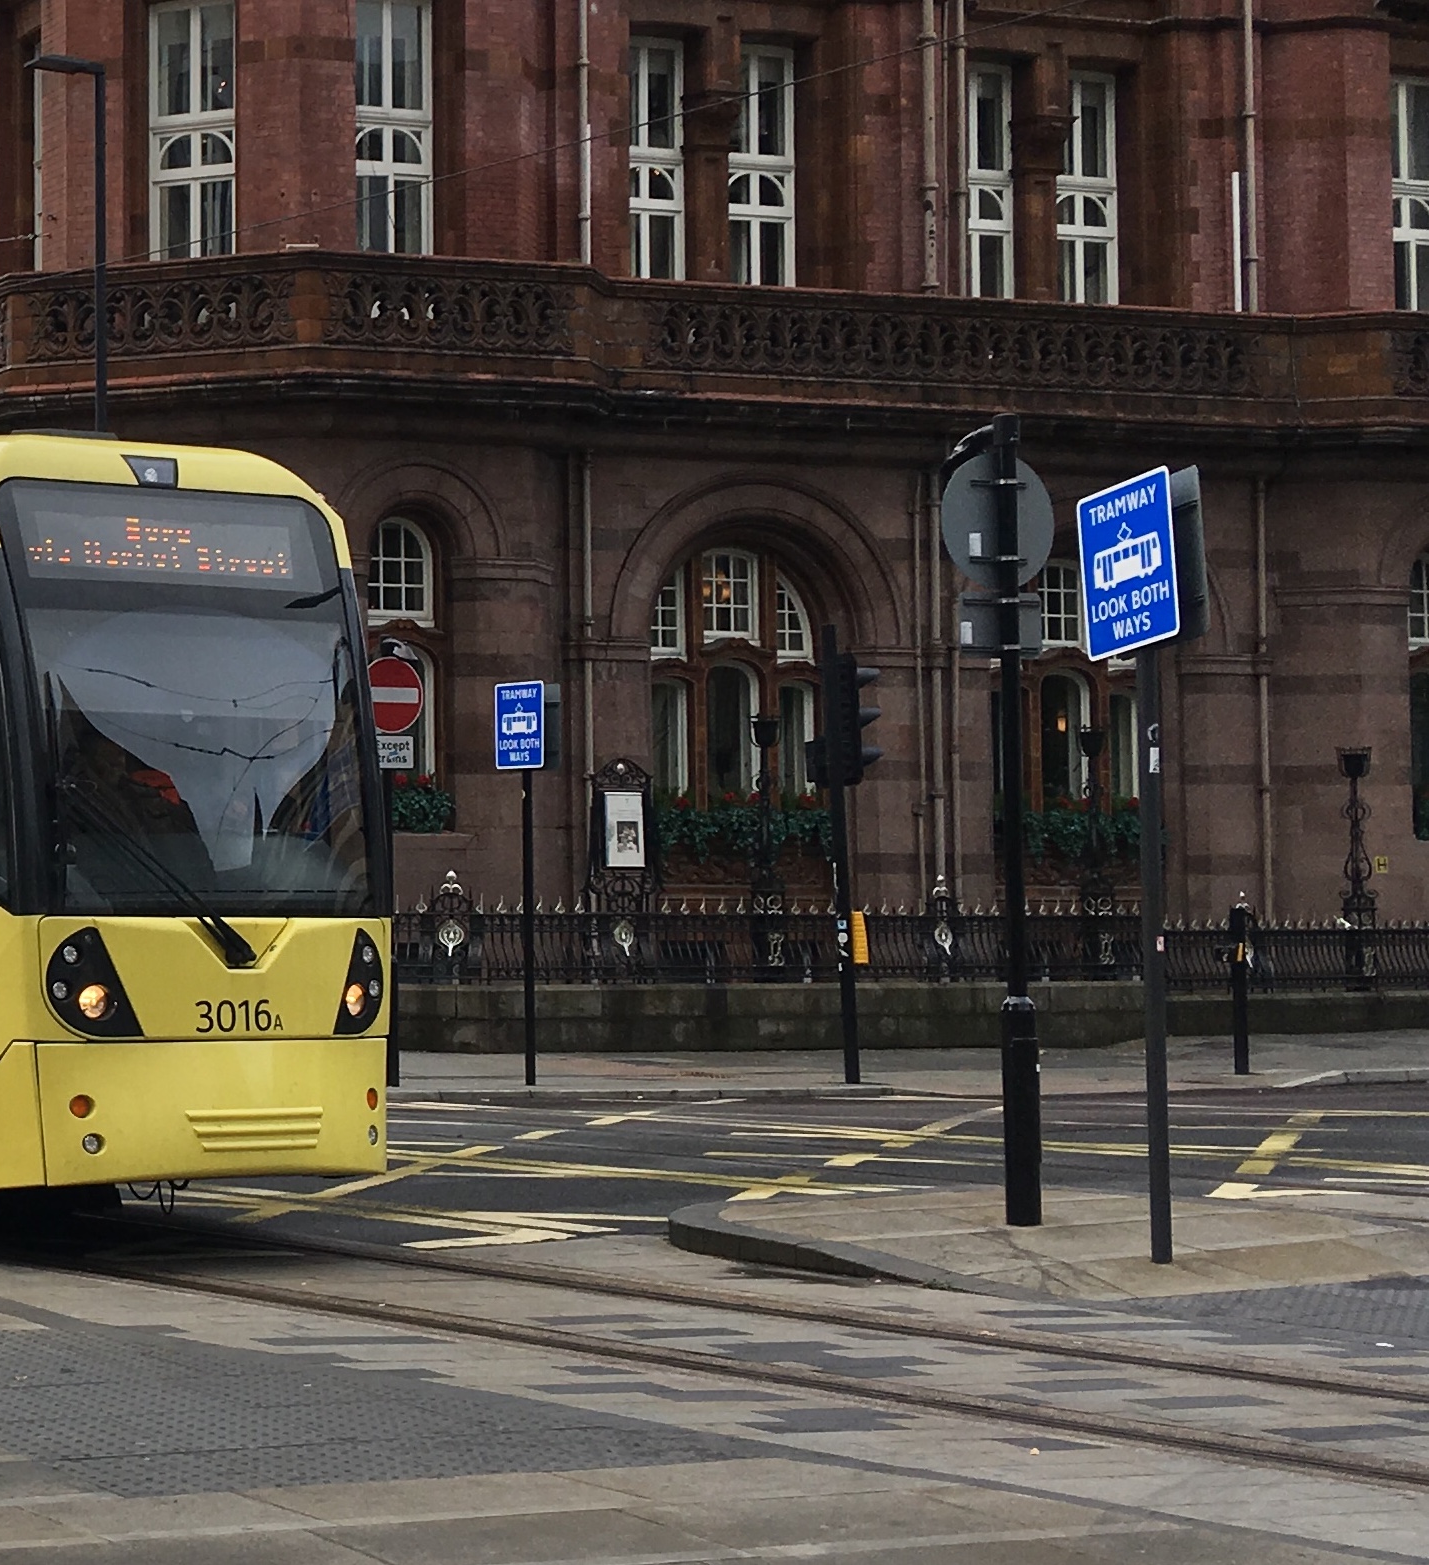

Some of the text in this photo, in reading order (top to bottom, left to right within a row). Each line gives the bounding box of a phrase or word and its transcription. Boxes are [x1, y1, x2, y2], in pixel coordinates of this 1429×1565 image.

[1088, 482, 1157, 526] TRAMWAY
[1091, 578, 1170, 624] LOOK BOTH
[1112, 611, 1152, 641] WAYS
[500, 687, 538, 701] TRAMWAY
[499, 737, 540, 751] LOOK BOTH
[509, 751, 530, 762] WAYS
[1376, 857, 1387, 872] H
